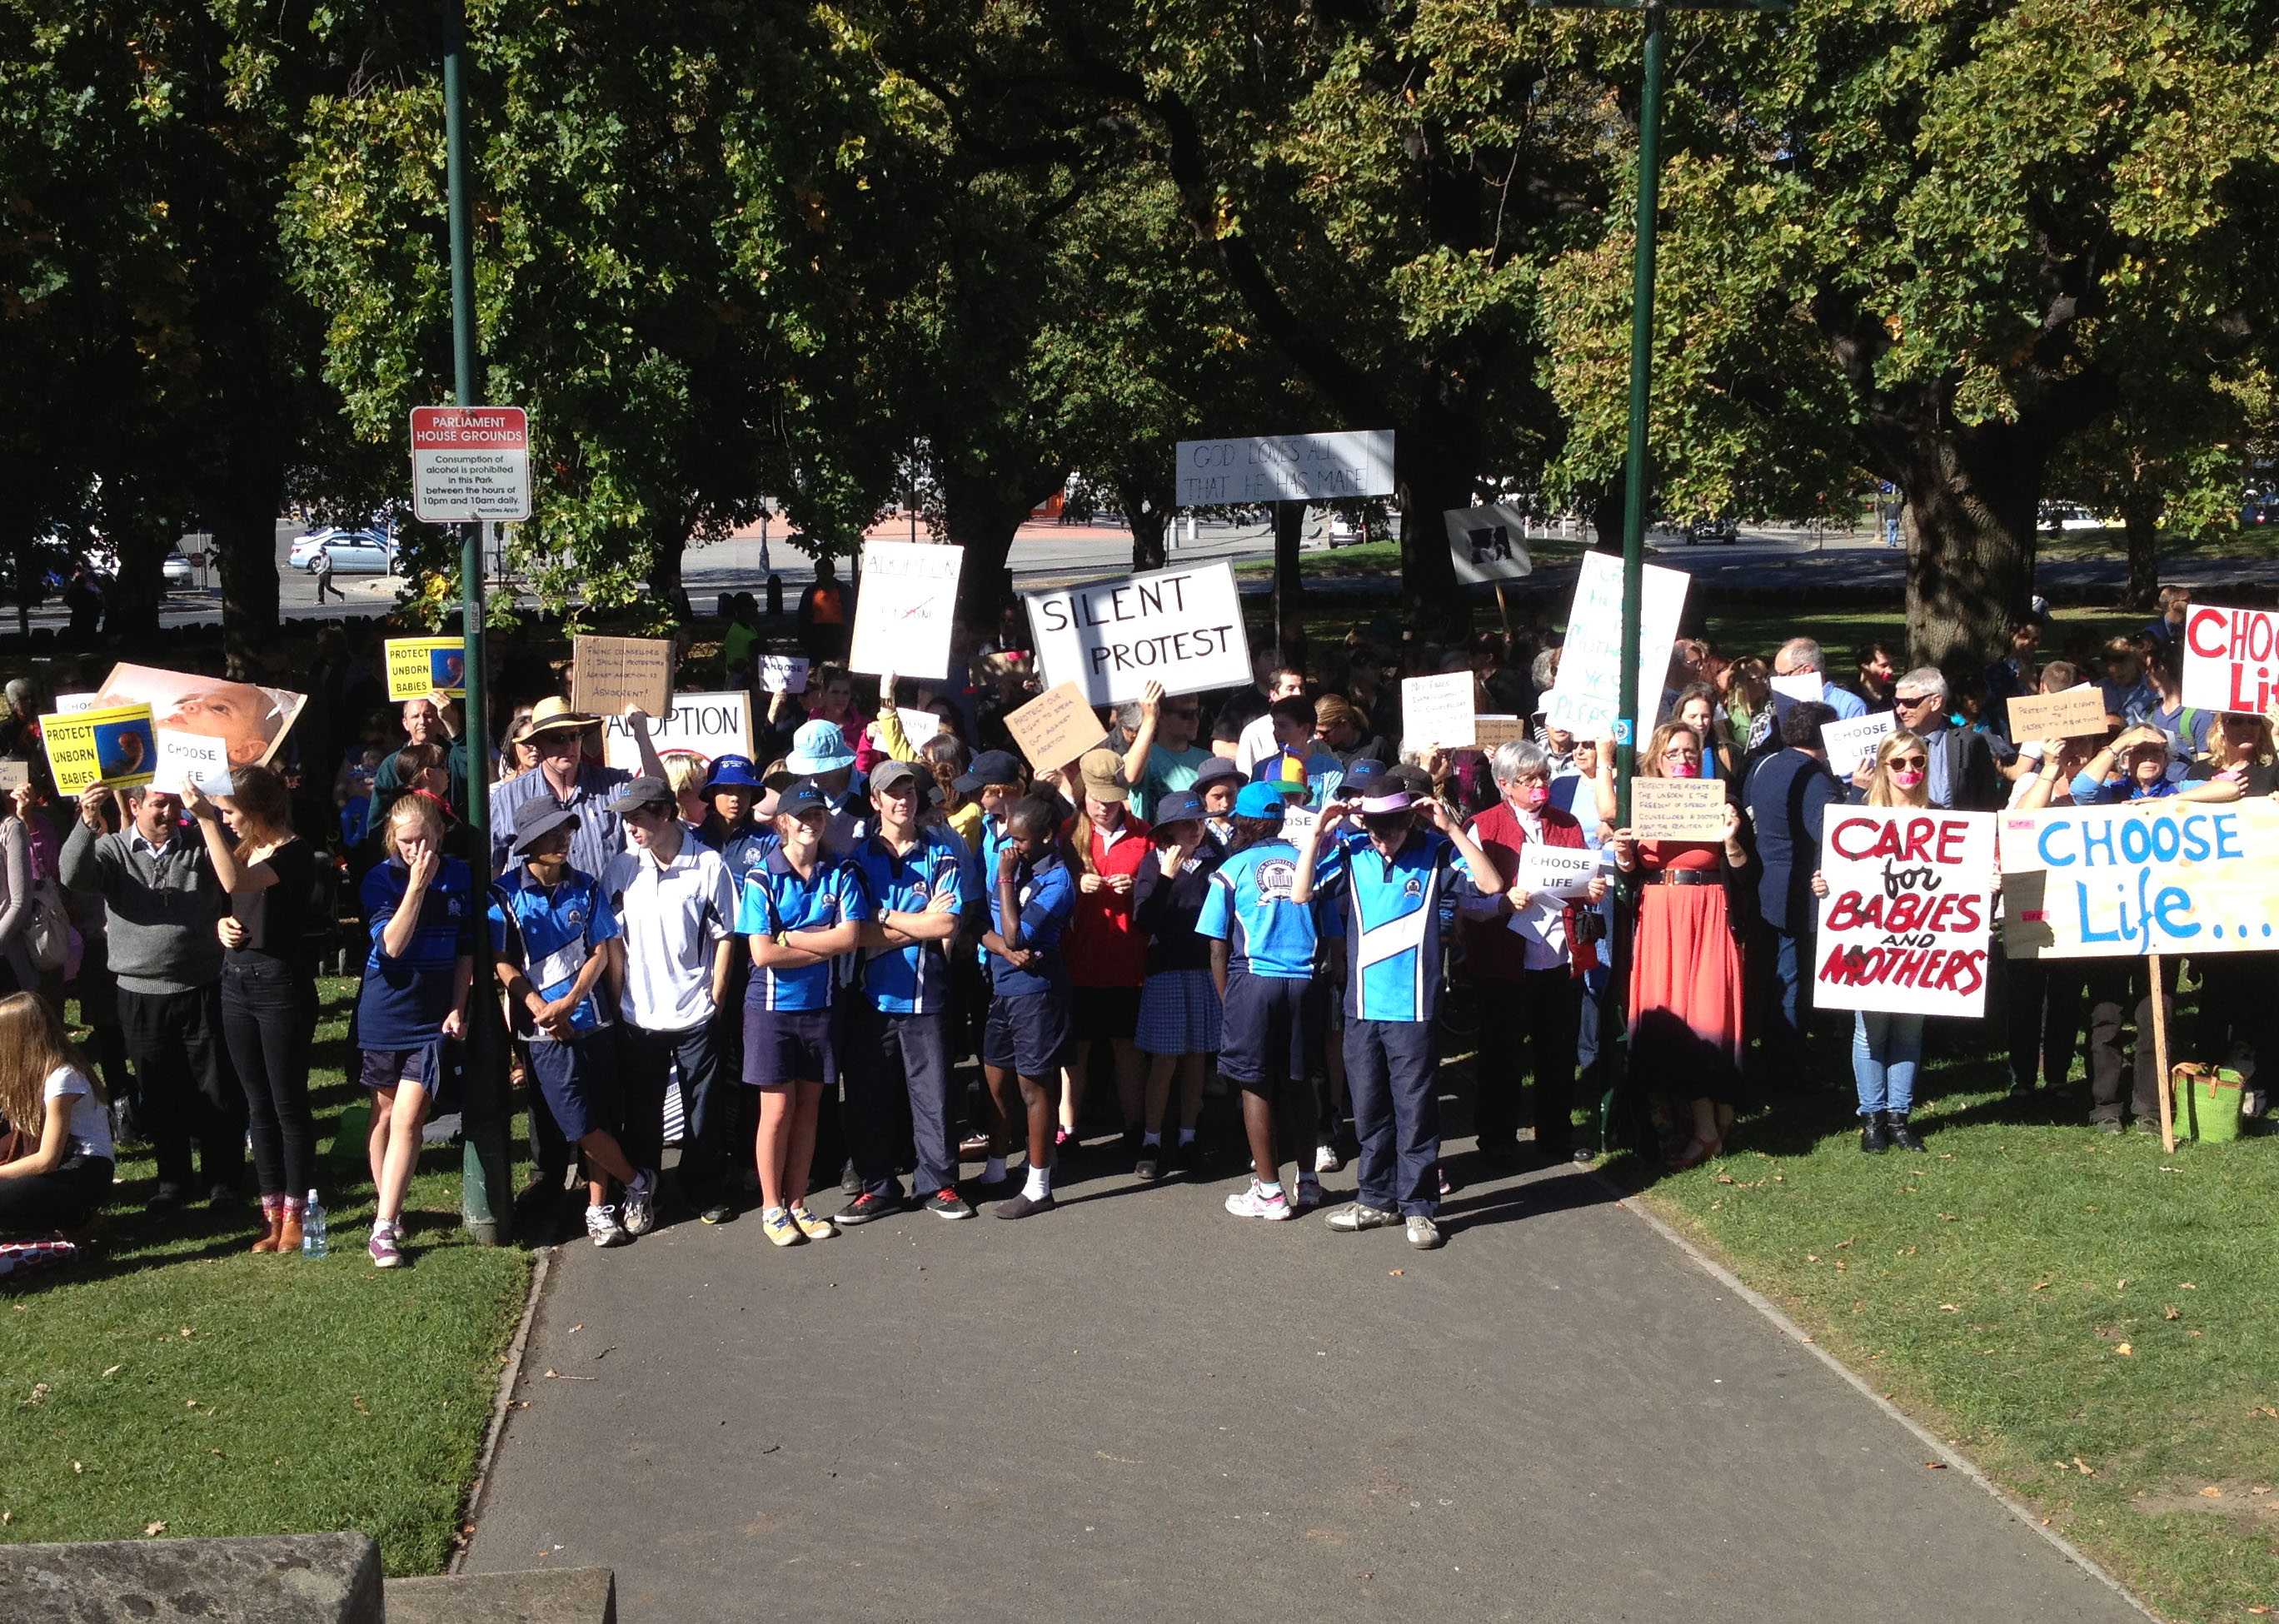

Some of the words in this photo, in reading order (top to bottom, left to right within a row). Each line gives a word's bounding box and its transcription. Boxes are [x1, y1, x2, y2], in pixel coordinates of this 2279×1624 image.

[432, 416, 506, 428] PARLIAMENT
[416, 431, 457, 442] HOUSE
[461, 431, 522, 441] GROUNDS
[1193, 444, 1236, 468] GOD
[1247, 439, 1301, 464] LOVES
[1306, 438, 1336, 461] ALL
[435, 456, 492, 465] Consumption
[494, 456, 504, 464] of
[426, 466, 459, 474] alcohol
[461, 466, 468, 474] is
[469, 466, 514, 476] prohibited
[426, 486, 464, 495] between
[466, 486, 480, 495] the
[481, 486, 505, 495] hours
[506, 486, 516, 495] of
[1184, 476, 1229, 501] THAT
[1244, 474, 1267, 498] HE
[1276, 472, 1308, 496] HAS
[1318, 469, 1366, 493] MADE
[423, 496, 448, 506] 10pm
[451, 496, 468, 505] and
[470, 496, 496, 505] 10am
[497, 496, 521, 506] daily.
[1042, 575, 1191, 631] SILENT
[390, 648, 430, 659] PROTECT
[1090, 625, 1233, 675] PROTEST
[392, 665, 430, 675] UNBORN
[396, 681, 427, 692] BABIES
[47, 725, 92, 741] PROTECT
[1833, 723, 1888, 740] CHOOSE
[52, 749, 95, 763] UNBORN
[167, 743, 217, 761] CHOOSE
[1853, 744, 1878, 757] LIFE
[61, 771, 95, 785] BABIES
[1831, 817, 1970, 864] CARE
[2037, 813, 2244, 867] CHOOSE
[1531, 857, 1590, 870] CHOOSE
[1543, 878, 1573, 888] LIFE
[1881, 858, 1942, 899] for
[1826, 890, 1981, 933] BABIES
[1881, 934, 1936, 949] AND
[1819, 944, 1988, 997] MOTHERS
